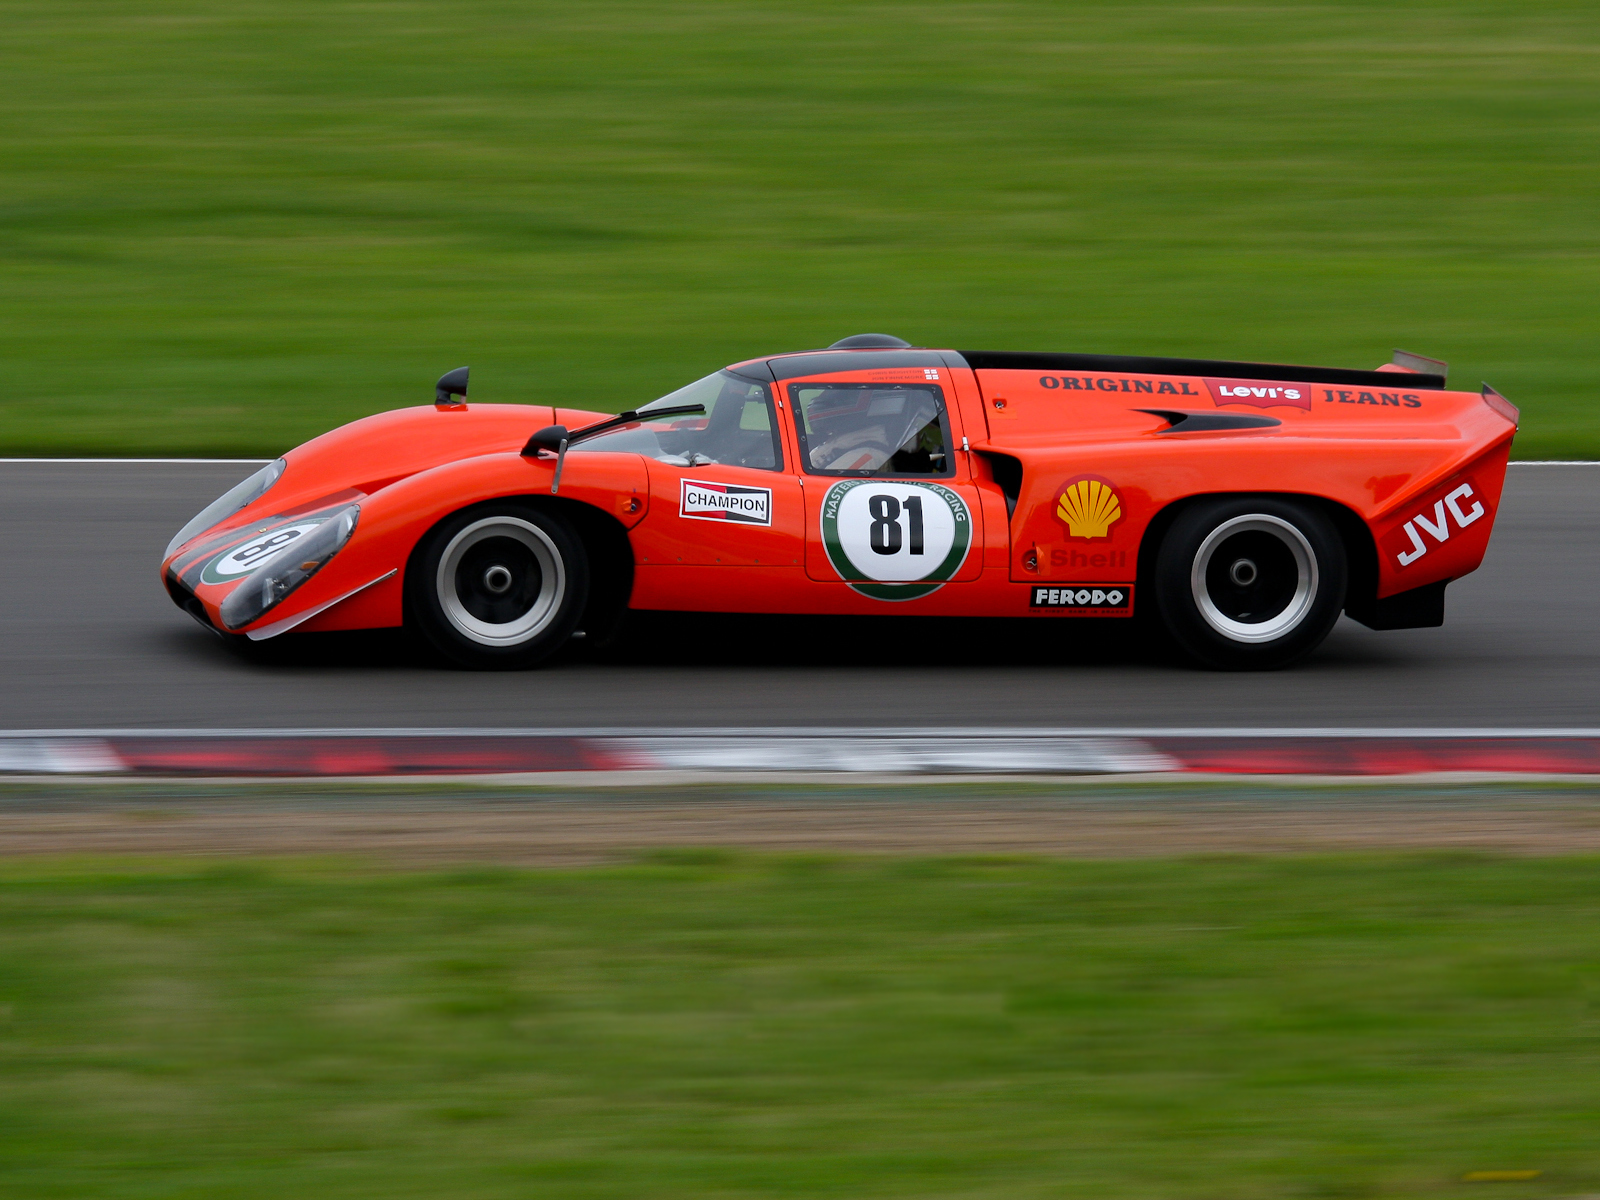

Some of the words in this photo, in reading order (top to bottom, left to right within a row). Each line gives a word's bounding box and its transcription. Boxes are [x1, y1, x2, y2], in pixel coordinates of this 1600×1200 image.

[1039, 376, 1199, 396] ORIGINAL
[1322, 389, 1422, 408] JEANS
[687, 492, 765, 512] CHAMPION
[825, 480, 859, 519] MASTERS
[928, 484, 966, 522] RACING
[868, 494, 924, 556] 81
[1397, 483, 1485, 566] JVC
[1050, 549, 1126, 568] Shell
[1036, 589, 1123, 605] FERODO
